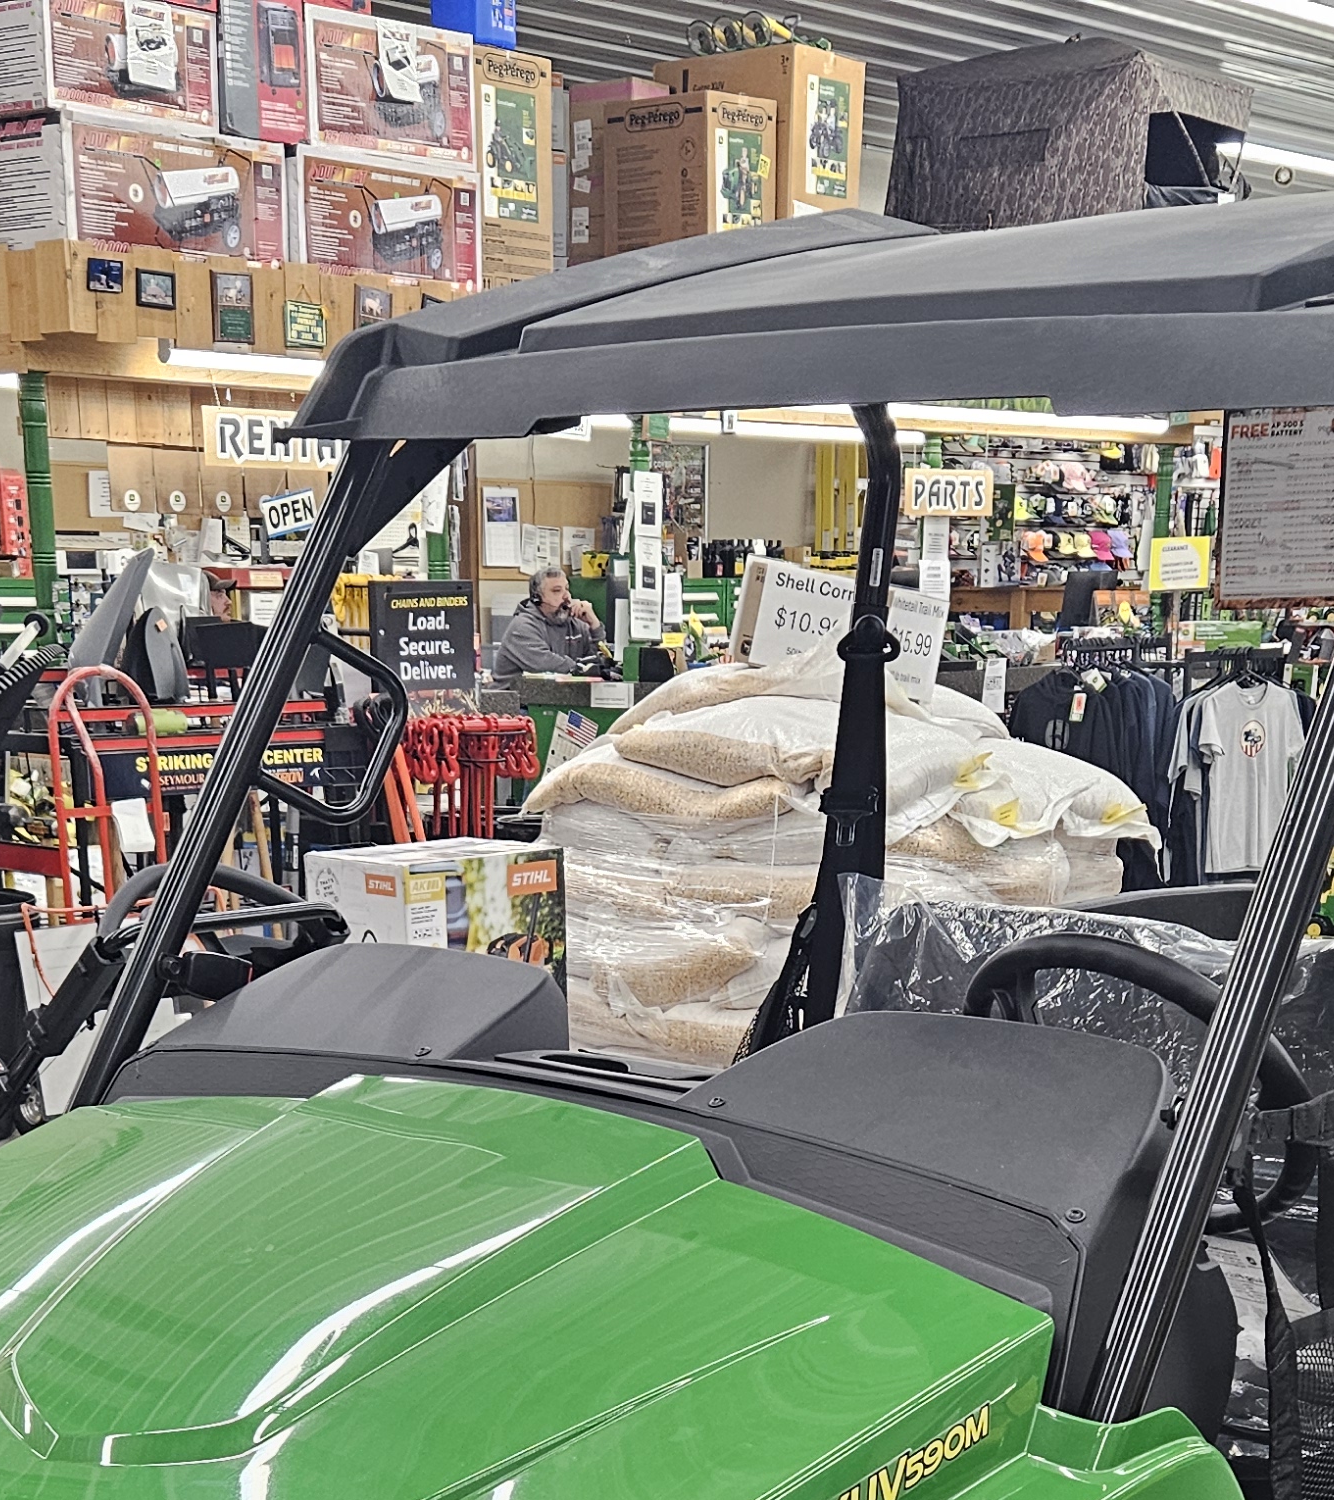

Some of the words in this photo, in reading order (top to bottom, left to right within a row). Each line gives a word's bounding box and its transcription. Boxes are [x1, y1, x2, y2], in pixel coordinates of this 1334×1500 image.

[486, 60, 536, 83] Peg-Pérego
[629, 106, 680, 127] Peg-Pérego
[721, 106, 764, 127] Peg-Pérego
[1231, 421, 1271, 440] FREE
[1271, 429, 1303, 437] BATTERY
[913, 475, 986, 510] PARTS
[268, 496, 315, 529] OPEN
[775, 571, 815, 594] Shell
[408, 610, 450, 632] Load.
[399, 636, 455, 656] Secure.
[399, 660, 457, 681] Deliver.
[135, 753, 214, 772] SRIKING
[263, 747, 323, 766] CENTER
[159, 773, 205, 787] SEYMOUR
[368, 879, 394, 892] STIHL
[512, 868, 551, 887] STIHL
